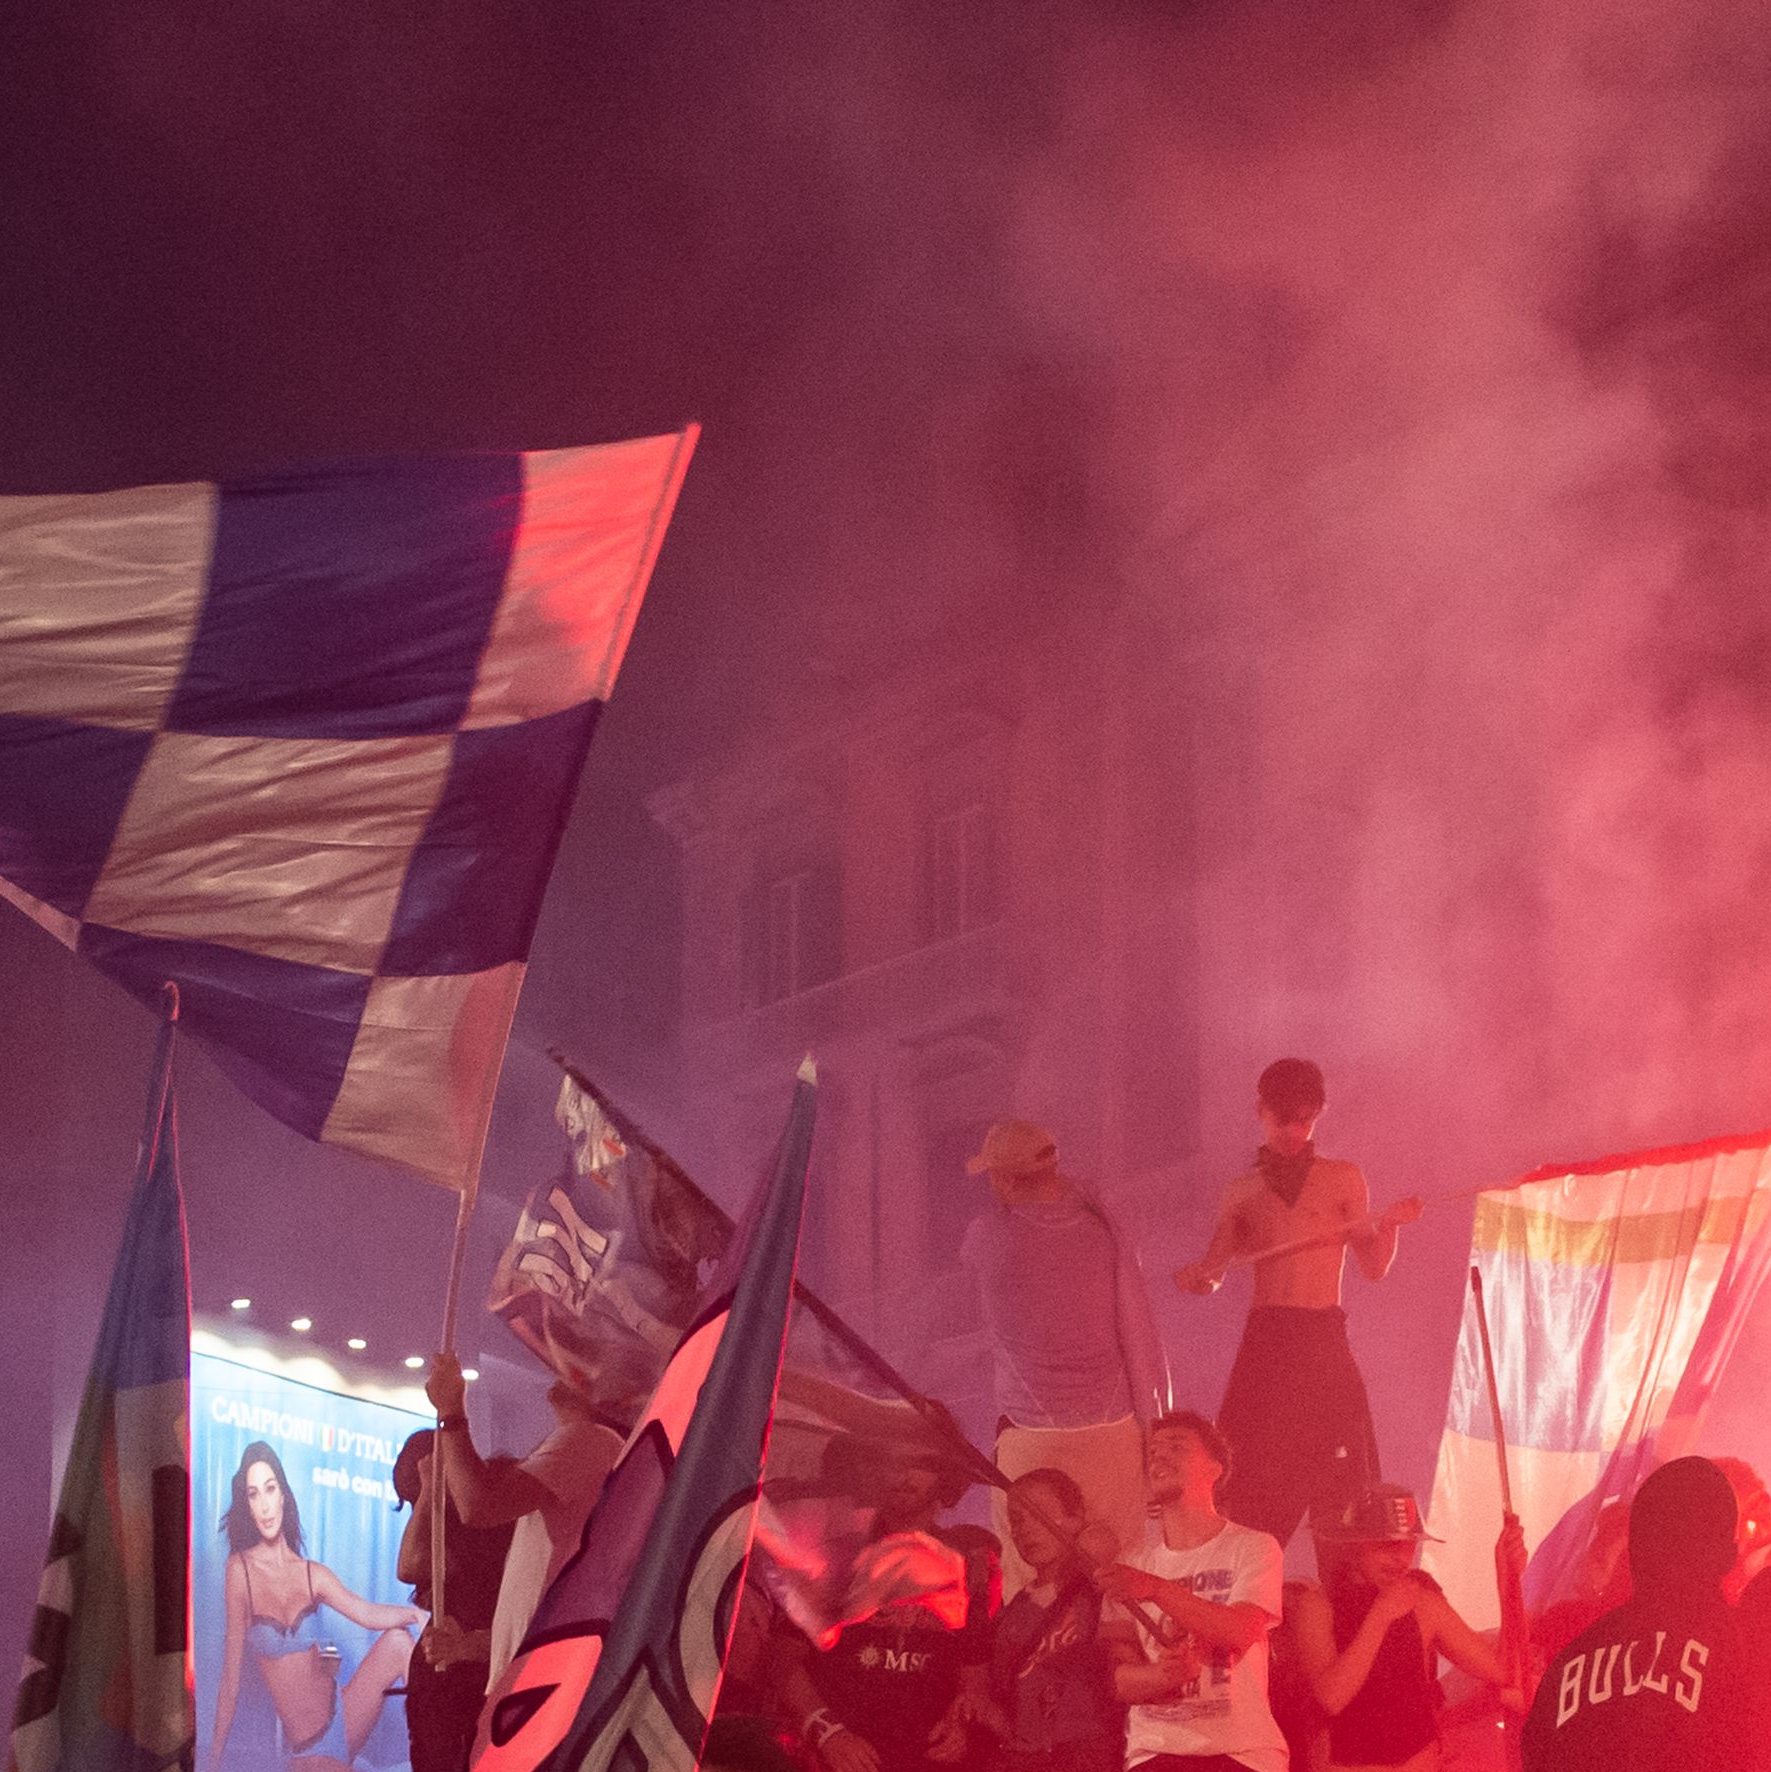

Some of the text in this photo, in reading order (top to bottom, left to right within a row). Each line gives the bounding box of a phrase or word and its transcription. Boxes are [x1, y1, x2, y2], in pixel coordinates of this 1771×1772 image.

[212, 1397, 402, 1466] CAMPIONI D'ITAL
[312, 1466, 350, 1490] sarò
[351, 1475, 384, 1498] con
[1555, 1631, 1710, 1729] BULLS
